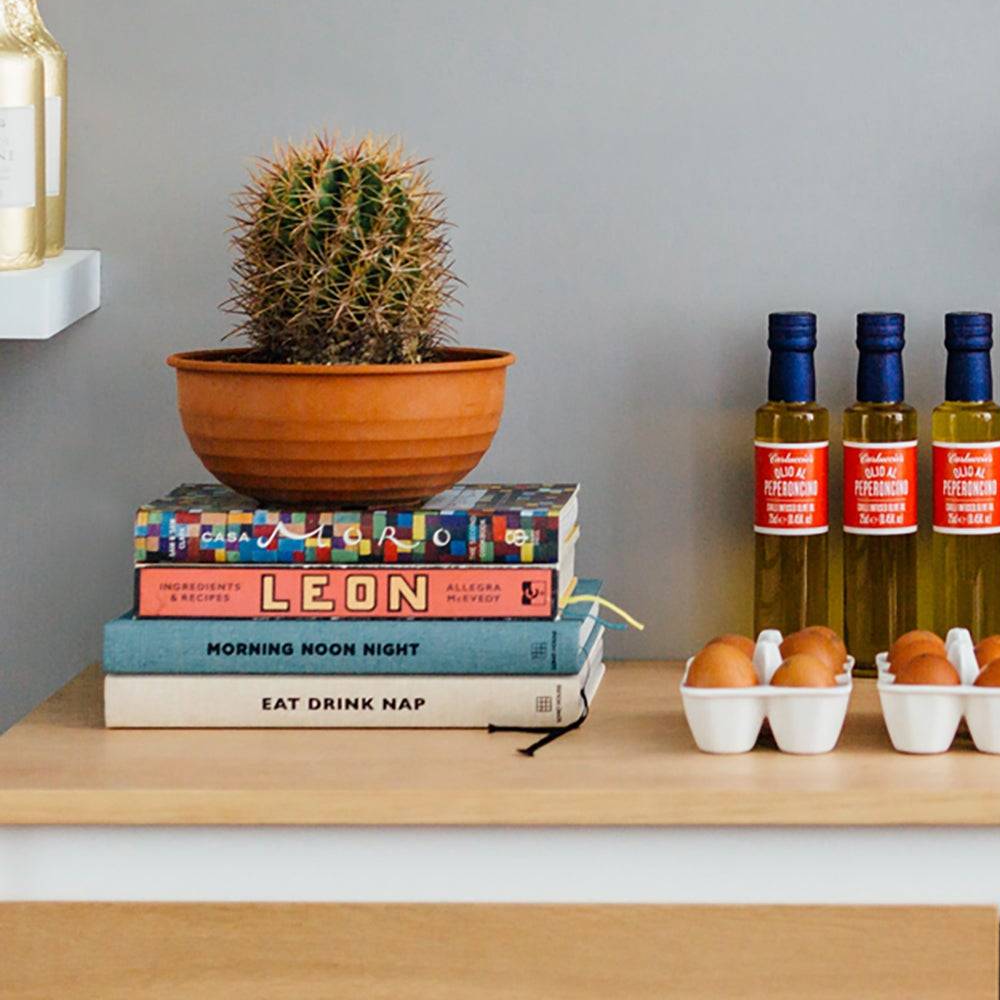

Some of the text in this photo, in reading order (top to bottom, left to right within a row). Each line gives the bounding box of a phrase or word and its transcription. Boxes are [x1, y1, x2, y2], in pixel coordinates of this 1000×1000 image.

[201, 531, 250, 543] CASA
[159, 582, 241, 592] INGREDIENTS
[260, 573, 429, 613] LEON
[446, 583, 502, 592] ALLEGRA
[170, 594, 230, 602] & RECIPES
[207, 642, 420, 656] MORNING NOON NIGHT
[261, 697, 426, 710] EAT DRINK NAP
